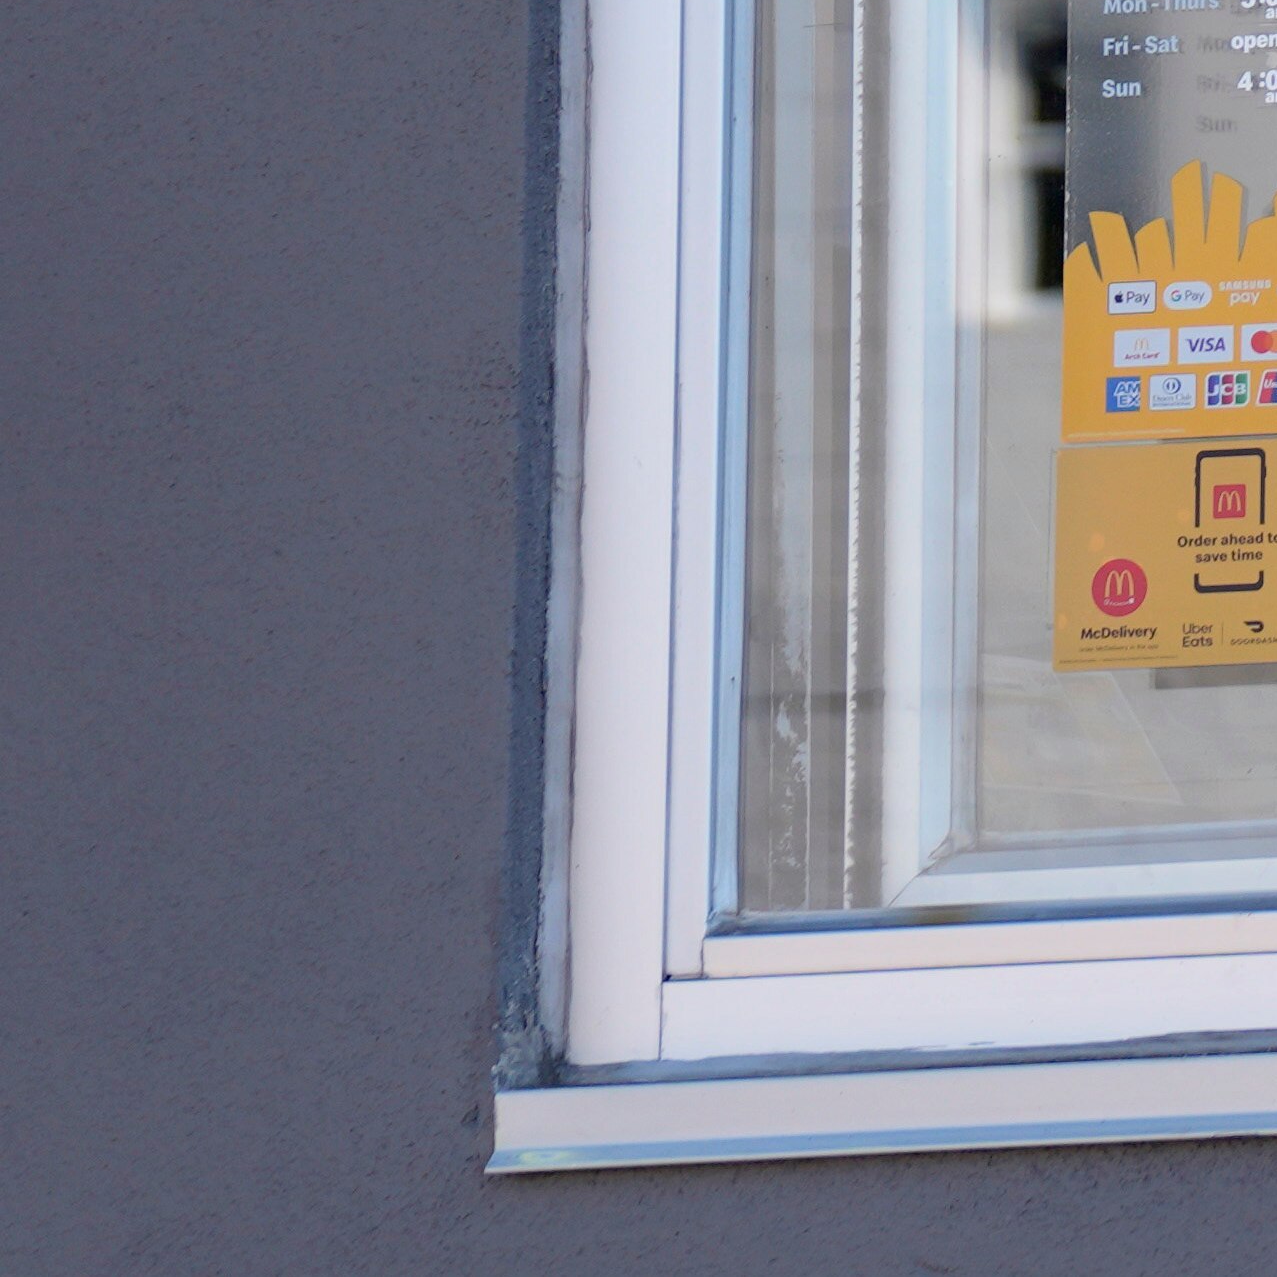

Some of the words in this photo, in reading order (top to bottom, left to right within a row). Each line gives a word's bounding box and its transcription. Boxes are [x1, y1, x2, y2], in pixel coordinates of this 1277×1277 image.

[1102, 79, 1142, 99] Sun
[1219, 279, 1272, 291] SAMSUNG
[1126, 290, 1151, 306] Pay
[1185, 290, 1205, 304] Pay
[1229, 291, 1261, 307] pay
[1186, 337, 1226, 353] VISA
[1207, 381, 1247, 398] JCB
[1177, 534, 1218, 548] Order
[1220, 532, 1264, 546] ahead
[1195, 551, 1227, 563] save
[1231, 549, 1263, 562] time
[1080, 625, 1158, 640] McDelivery
[1182, 623, 1214, 635] Uber
[1182, 636, 1213, 648] Eats
